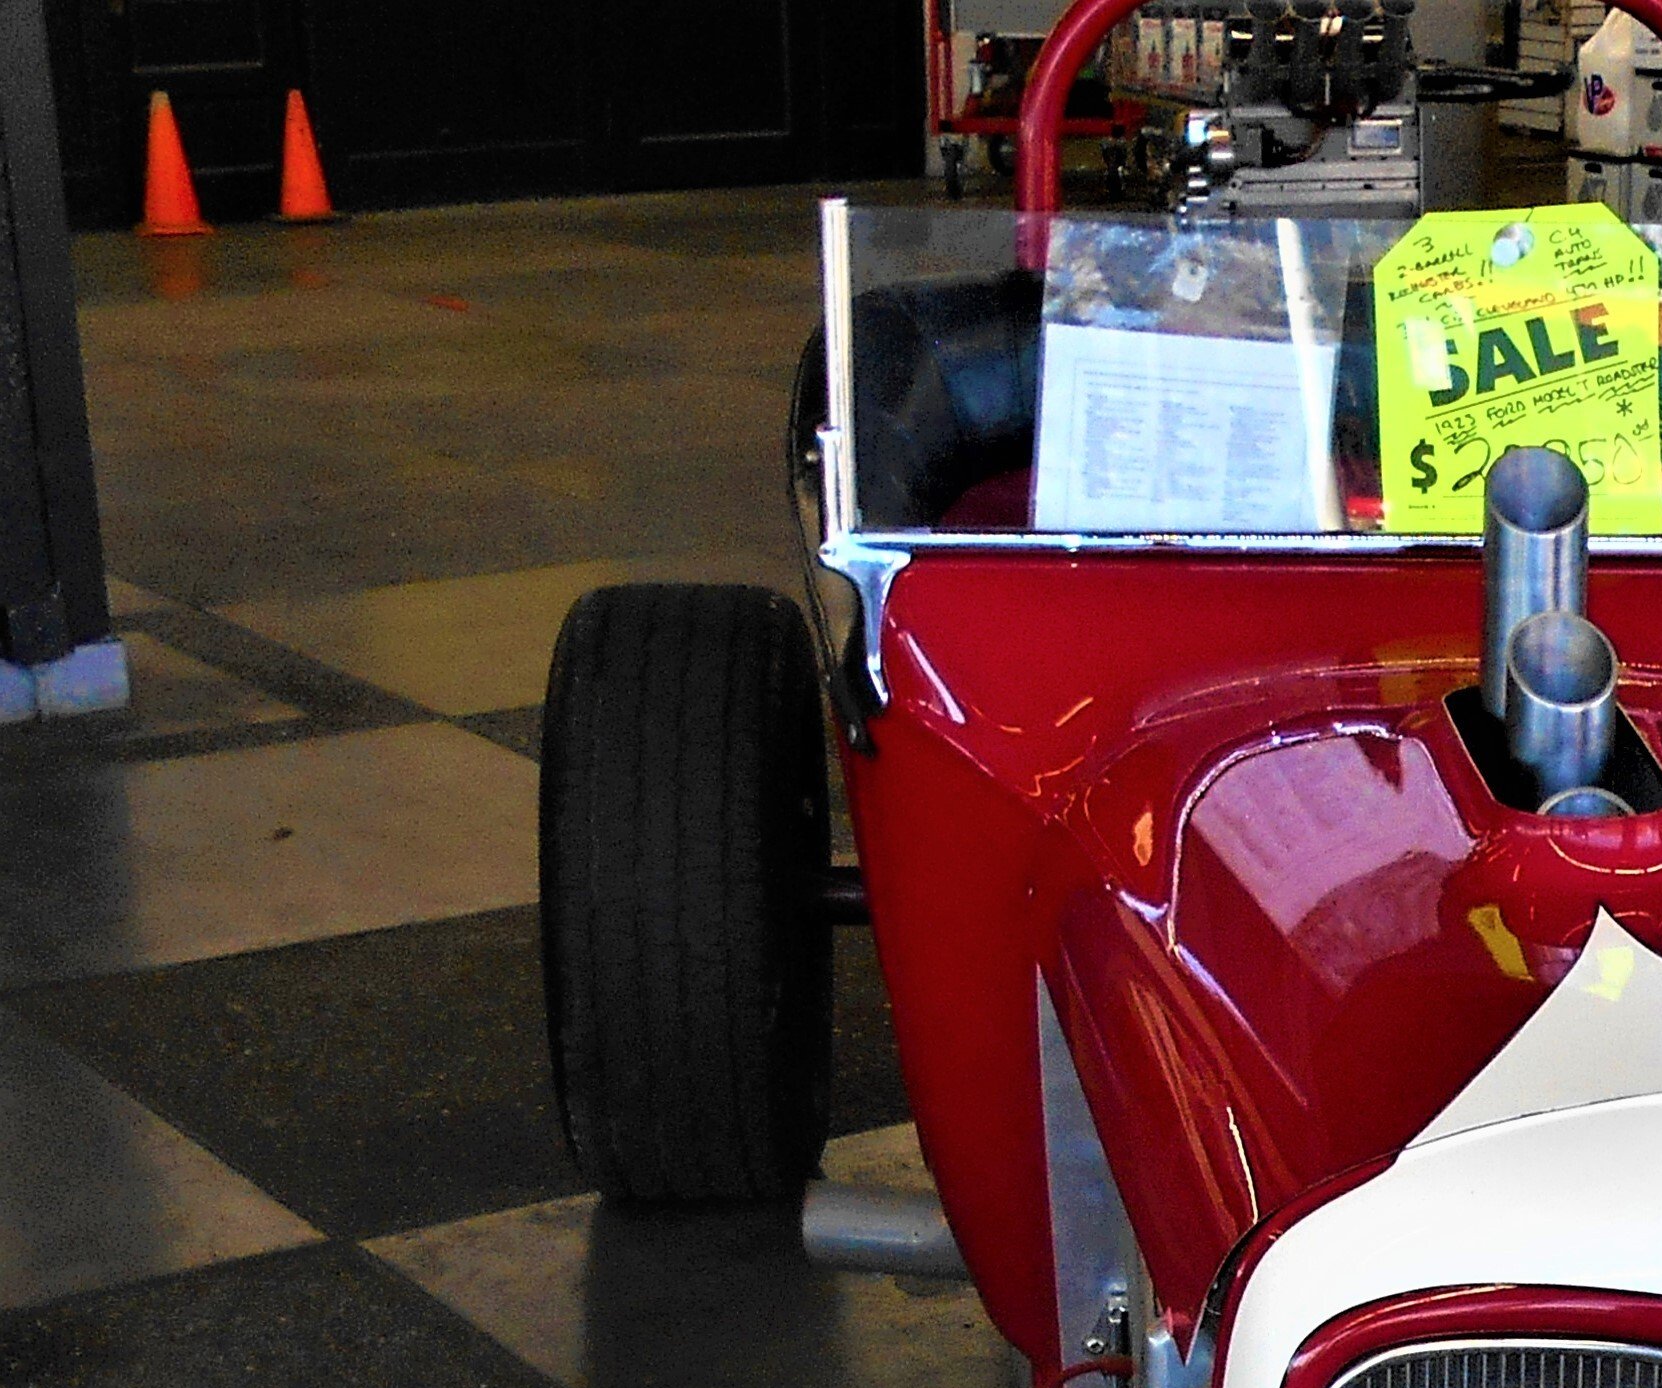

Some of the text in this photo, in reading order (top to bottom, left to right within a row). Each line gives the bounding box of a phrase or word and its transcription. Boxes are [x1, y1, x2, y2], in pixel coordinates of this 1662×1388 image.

[1413, 236, 1435, 254] 3
[1554, 238, 1592, 260] AUTO
[1427, 302, 1621, 408] SALE
[1486, 400, 1527, 421] FORD
